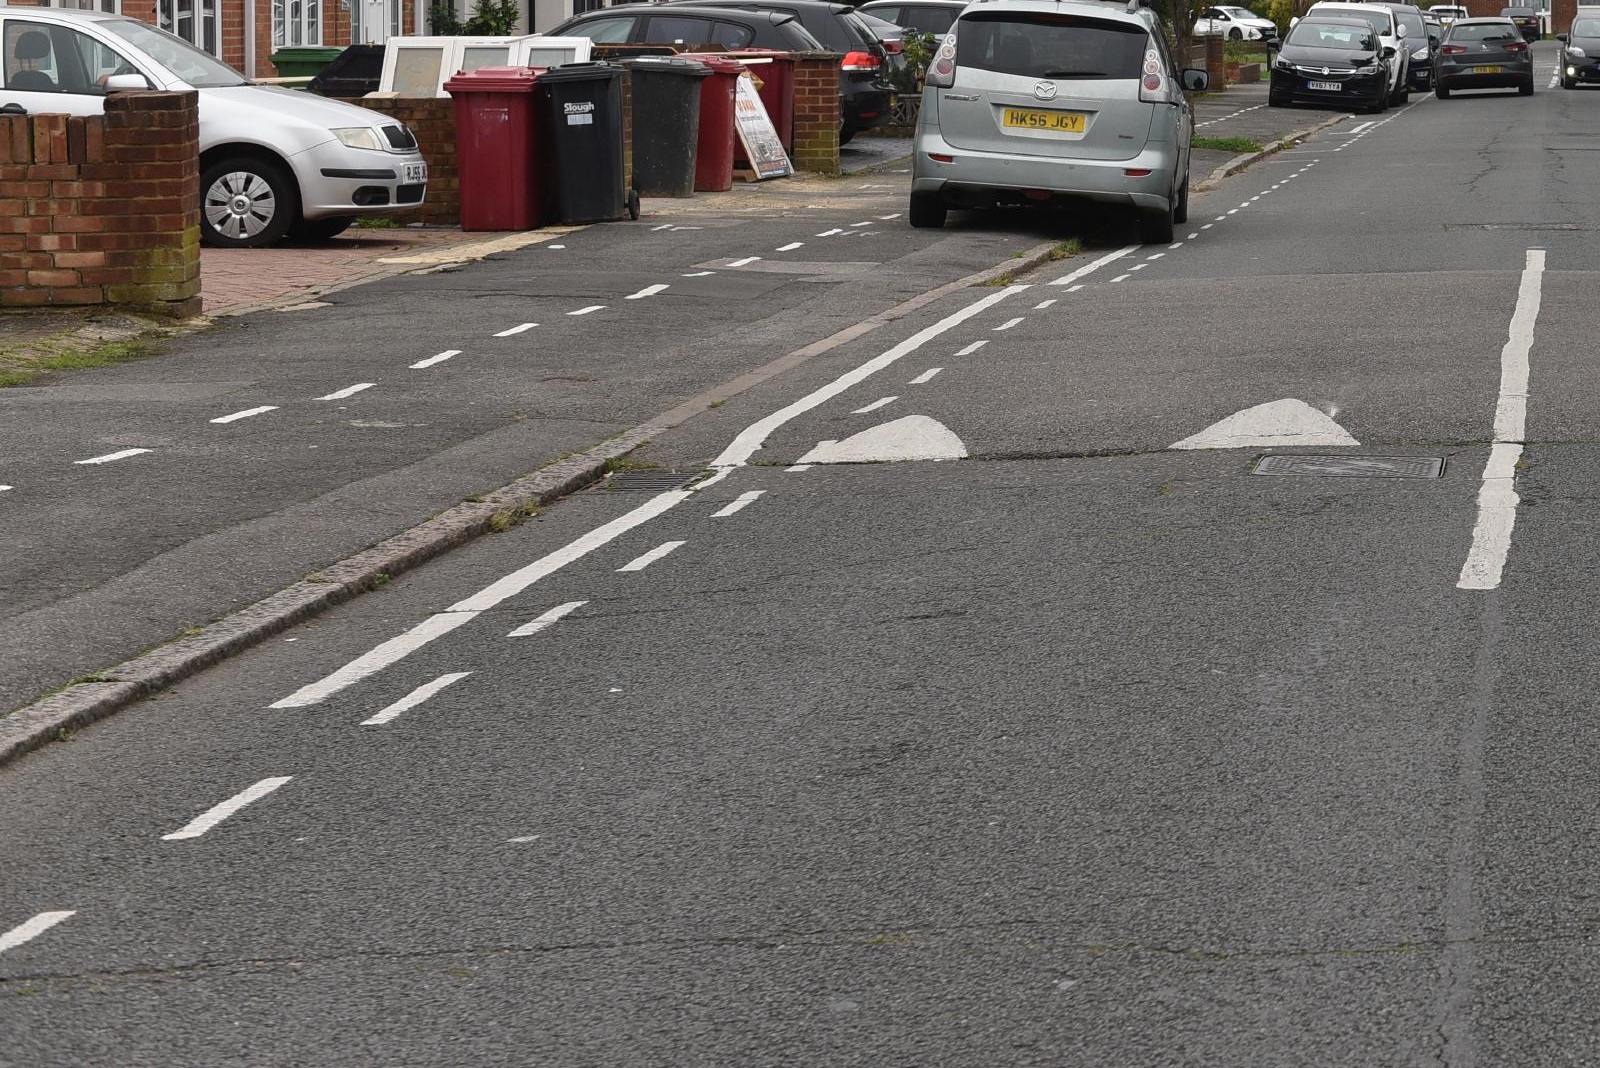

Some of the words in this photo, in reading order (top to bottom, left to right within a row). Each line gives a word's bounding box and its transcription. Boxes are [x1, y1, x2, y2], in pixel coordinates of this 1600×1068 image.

[564, 102, 595, 112] Slough
[1010, 112, 1047, 126] HK56
[1051, 116, 1078, 129] JGY
